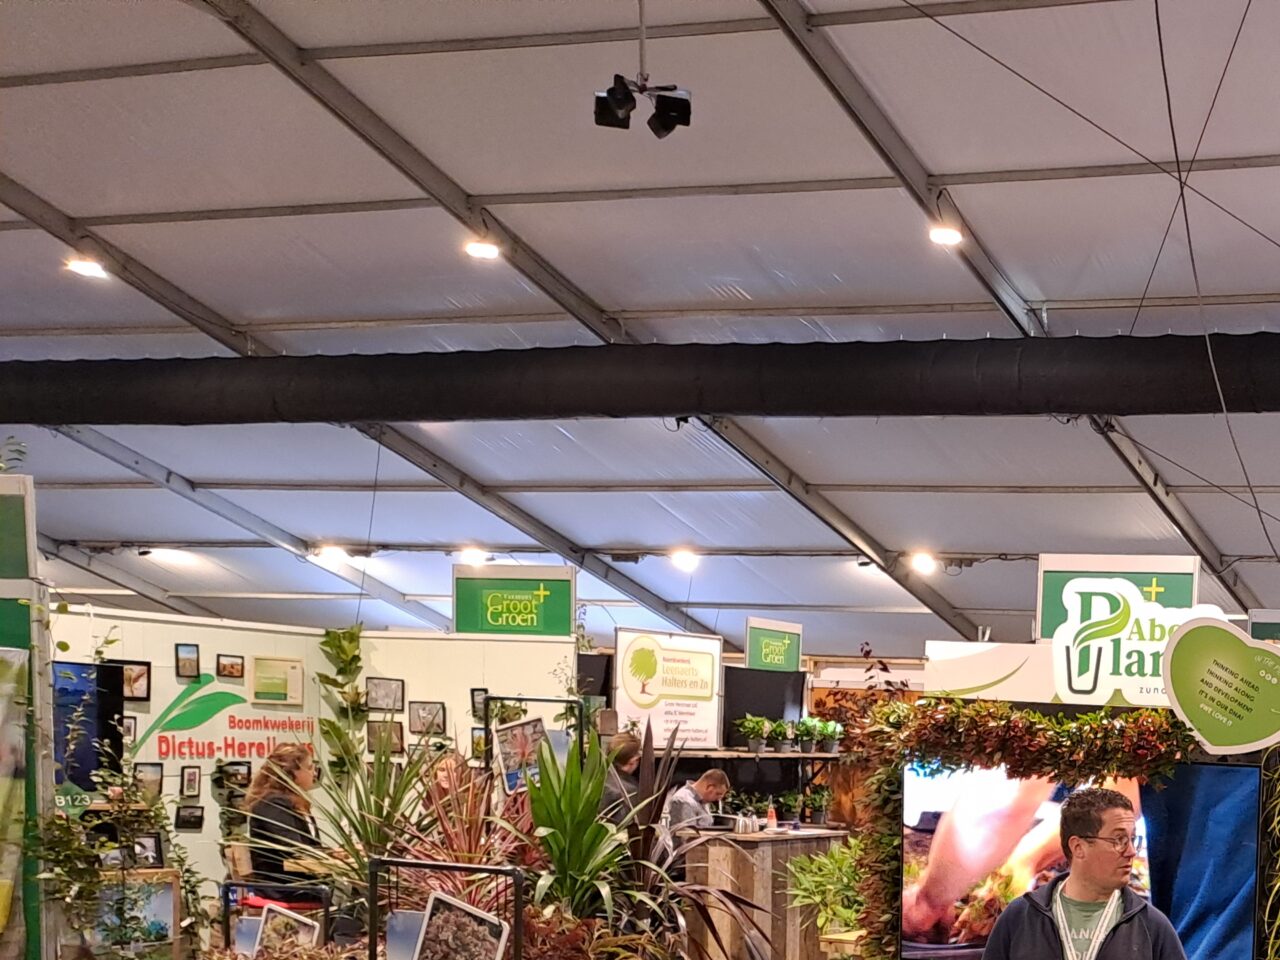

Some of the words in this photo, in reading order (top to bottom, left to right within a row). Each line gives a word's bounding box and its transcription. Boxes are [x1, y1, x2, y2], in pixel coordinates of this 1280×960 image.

[487, 593, 538, 613] Groot
[487, 605, 537, 626] Groen
[1212, 659, 1240, 680] THINKING
[661, 676, 688, 689] Halters
[688, 680, 699, 689] en
[1206, 668, 1234, 689] THINKING
[1233, 687, 1255, 702] ALONG
[1200, 678, 1213, 689] AND
[1213, 686, 1254, 713] DEVELOPMENT
[1216, 700, 1229, 711] OUR
[228, 715, 315, 736] Boomkwekerij
[54, 794, 91, 807] B123
